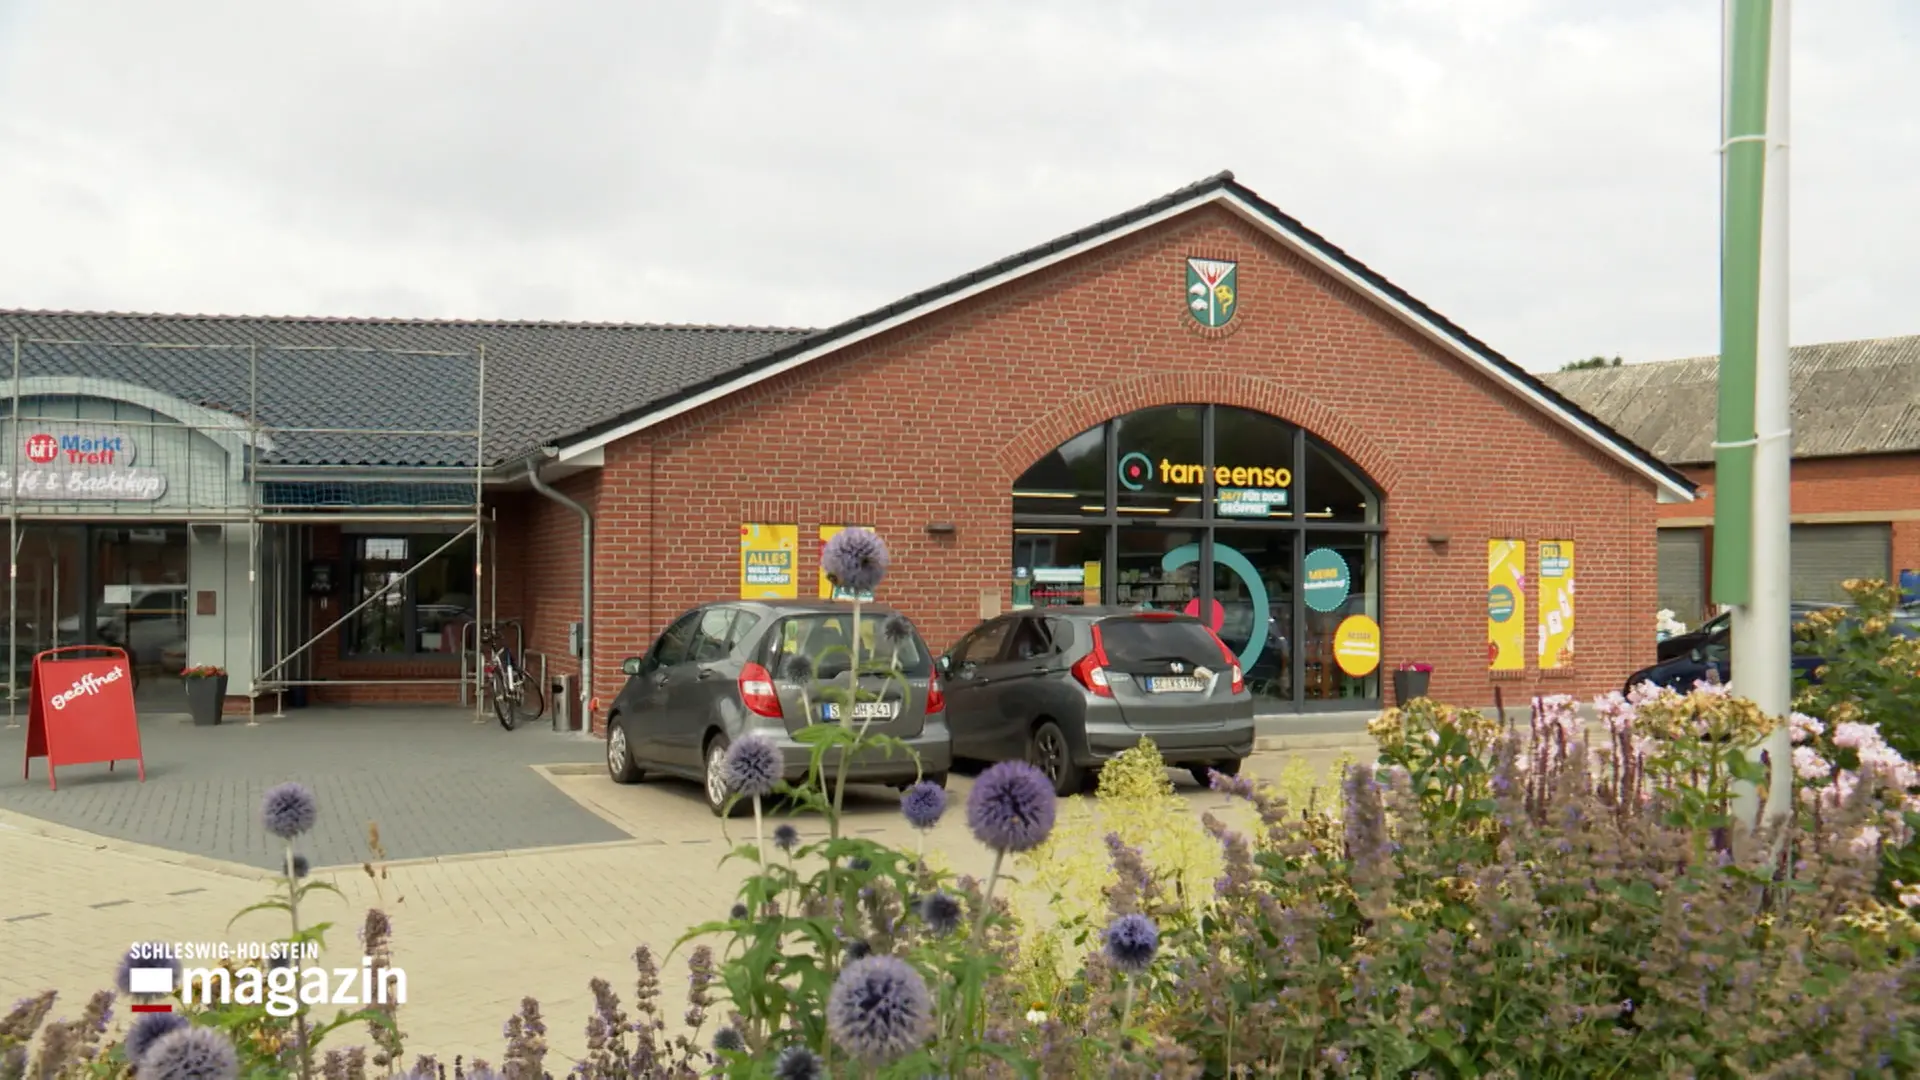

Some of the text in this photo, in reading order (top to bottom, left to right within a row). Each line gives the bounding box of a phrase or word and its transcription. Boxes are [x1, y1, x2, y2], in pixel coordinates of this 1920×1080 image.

[61, 434, 122, 451] Markt
[65, 449, 116, 465] Treff
[1159, 458, 1292, 487] taneenso
[747, 552, 789, 566] ALLES
[51, 665, 124, 711] geöffnet
